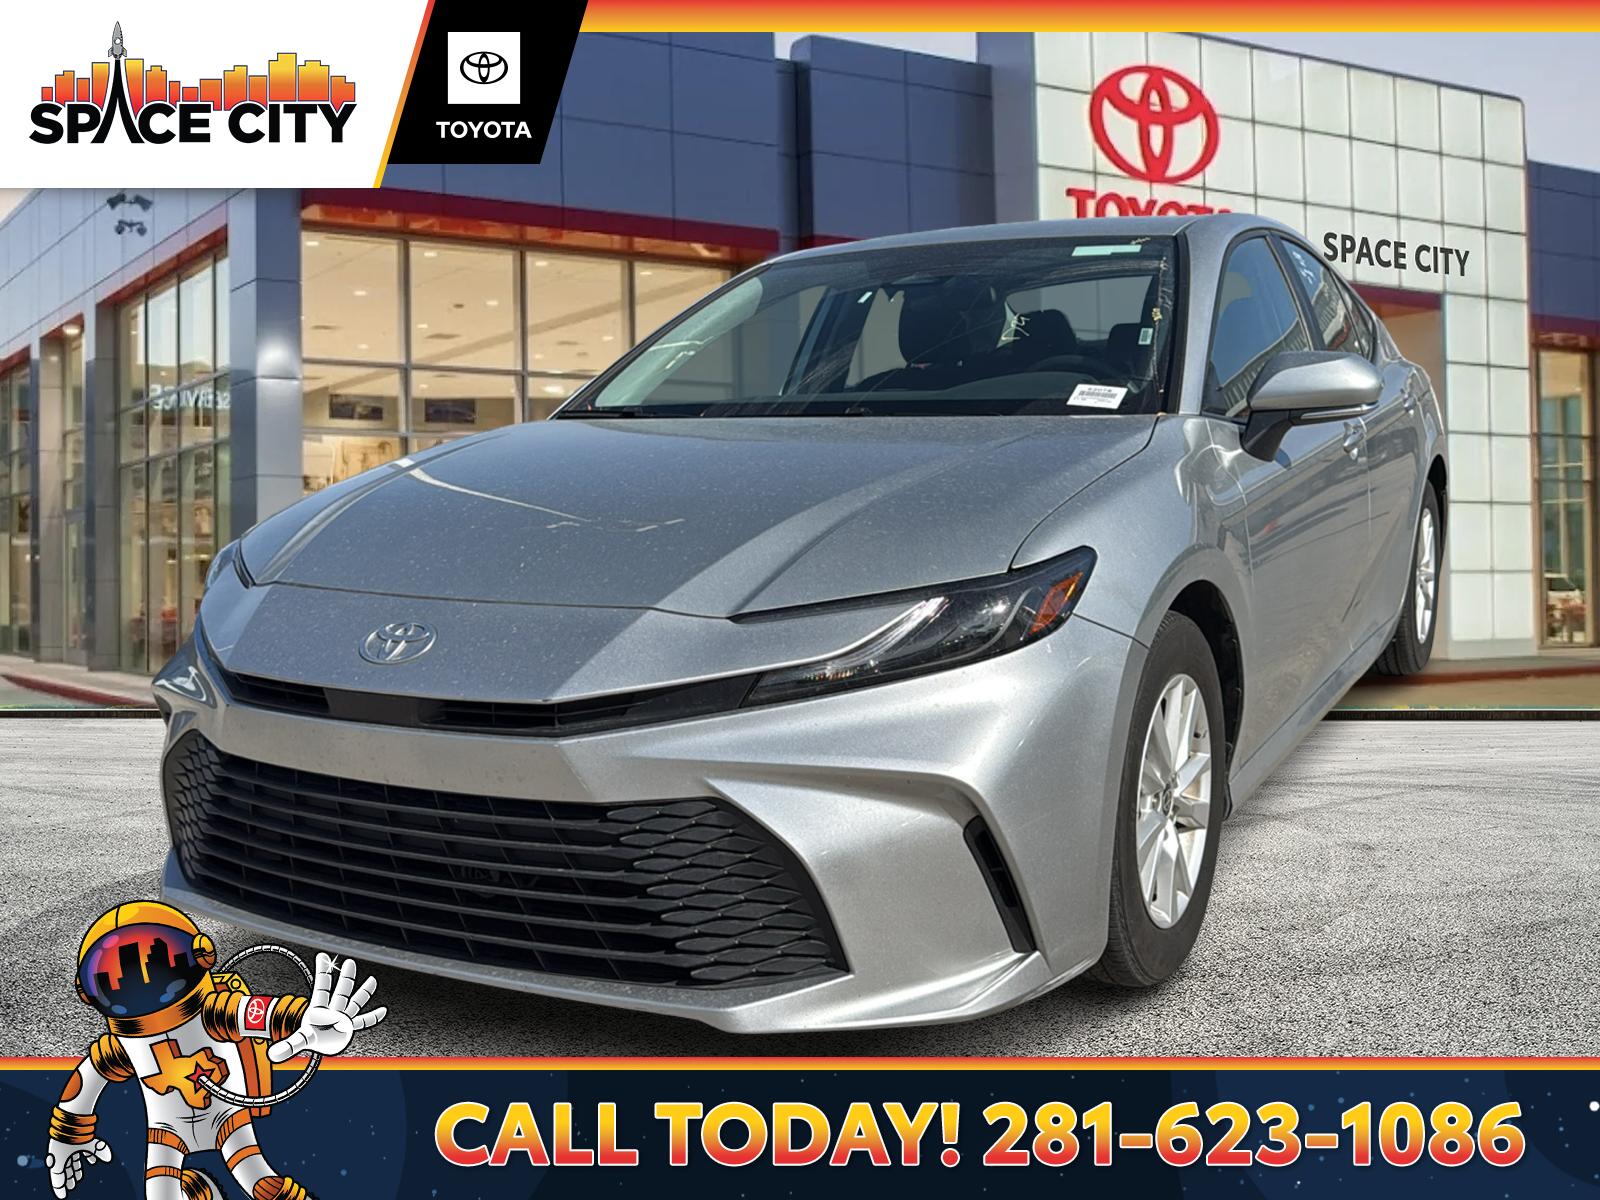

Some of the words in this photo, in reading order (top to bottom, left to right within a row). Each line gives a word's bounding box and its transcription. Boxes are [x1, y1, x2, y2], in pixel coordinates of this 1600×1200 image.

[1065, 187, 1232, 219] TOY
[1323, 232, 1407, 270] SPACE
[1414, 244, 1470, 277] CITY
